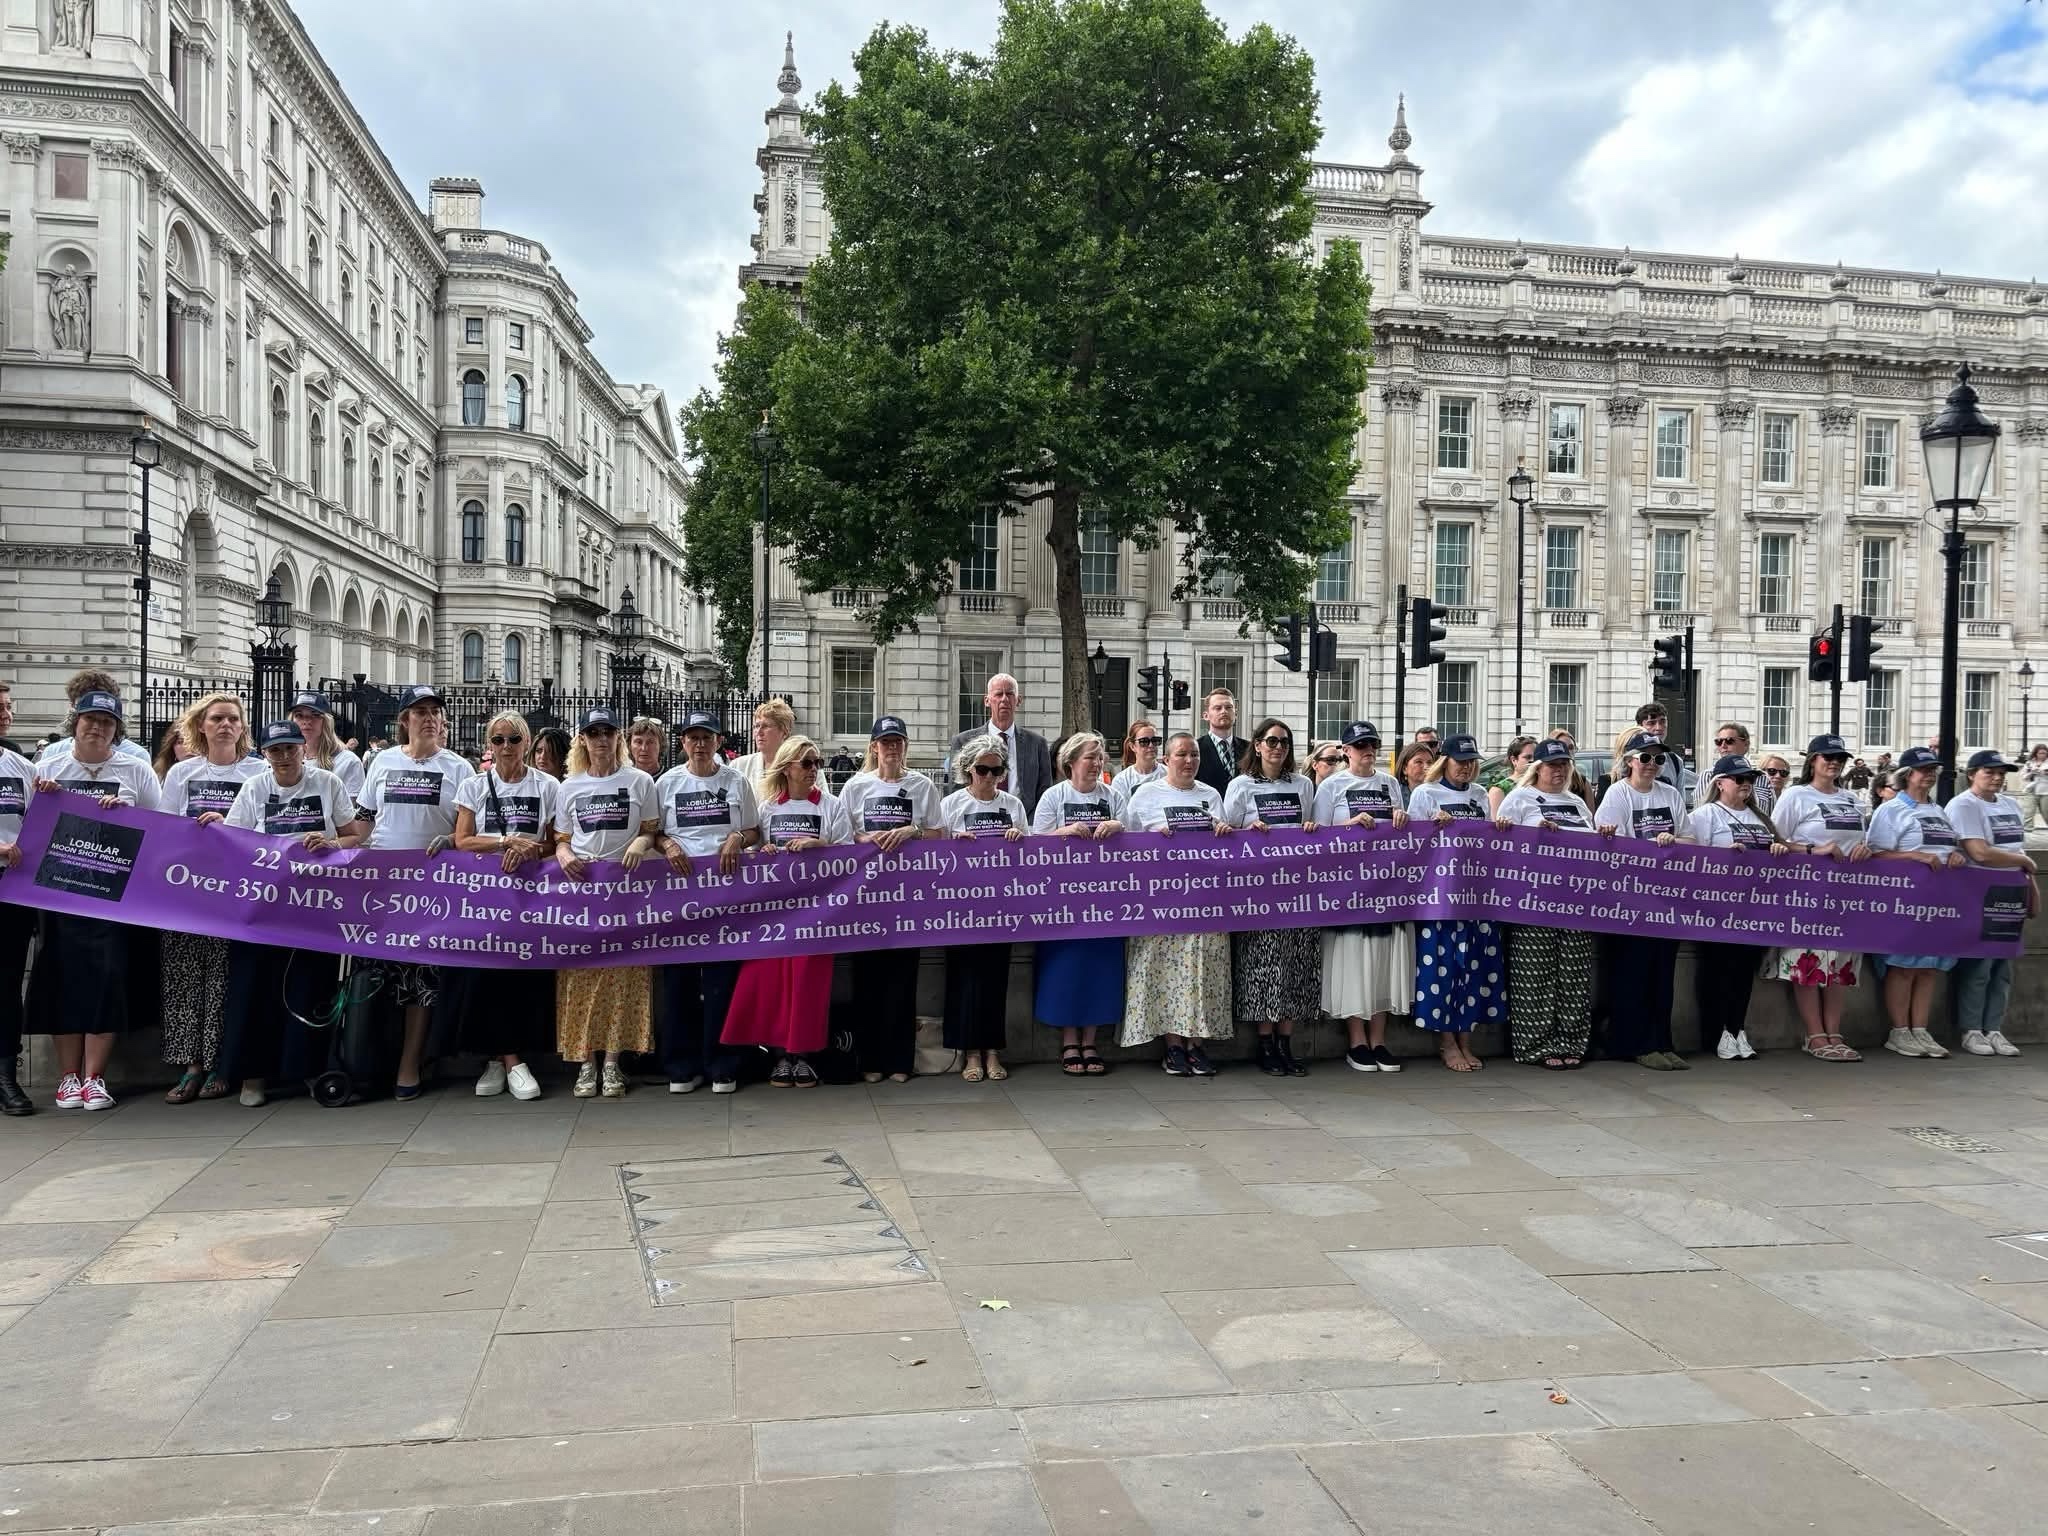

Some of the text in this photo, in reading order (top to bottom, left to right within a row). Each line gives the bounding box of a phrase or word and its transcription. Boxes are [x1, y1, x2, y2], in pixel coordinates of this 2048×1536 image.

[398, 776, 430, 784] LOBULAR
[200, 788, 234, 796] LOBULAR
[500, 804, 528, 812] OBULAR
[586, 802, 618, 810] LOBULAR
[686, 798, 718, 806] LOBULAR
[51, 843, 132, 865] MOON SHOT PROJECT
[70, 838, 120, 856] LOBULAR
[251, 830, 1916, 901] 22 women are diagnosed everyday in the UK (1,000 globally) with lobular breast cancer. A cancer that rarely shows on a mammogram and has no specific treatment.
[52, 875, 111, 892] lobularmoonshot.org
[165, 863, 230, 894] Over
[235, 878, 279, 903] 350
[287, 885, 344, 911] MPs
[362, 890, 451, 921] (>50%)
[459, 898, 512, 922] have
[520, 905, 590, 927] called
[598, 911, 628, 927] on
[636, 908, 673, 926] the
[681, 894, 820, 921] Government
[826, 891, 849, 907] to
[856, 883, 906, 905] fund
[912, 888, 924, 902] a
[1059, 871, 1141, 894] research
[1148, 872, 1220, 896] project
[1226, 870, 1265, 888] into
[1271, 867, 1301, 886] the
[1307, 864, 1353, 884] basic
[1359, 860, 1428, 883] biology
[1435, 858, 1456, 877] of
[1461, 859, 1488, 877] this
[1494, 867, 1563, 889] unique
[1568, 873, 1607, 897] type
[1612, 876, 1631, 893] of
[1633, 877, 1687, 899] breast
[1692, 887, 1746, 903] cancer
[1750, 885, 1778, 906] but
[1784, 891, 1818, 910] this
[1823, 894, 1836, 910] is
[1839, 898, 1865, 915] yet
[1870, 899, 1888, 914] to
[1893, 896, 1961, 923] happen.
[337, 887, 1844, 960] We are standing here in silence for 22 minutes, in solidarity with the 22 women who will be diagnosed with the disease today and who deserve better.
